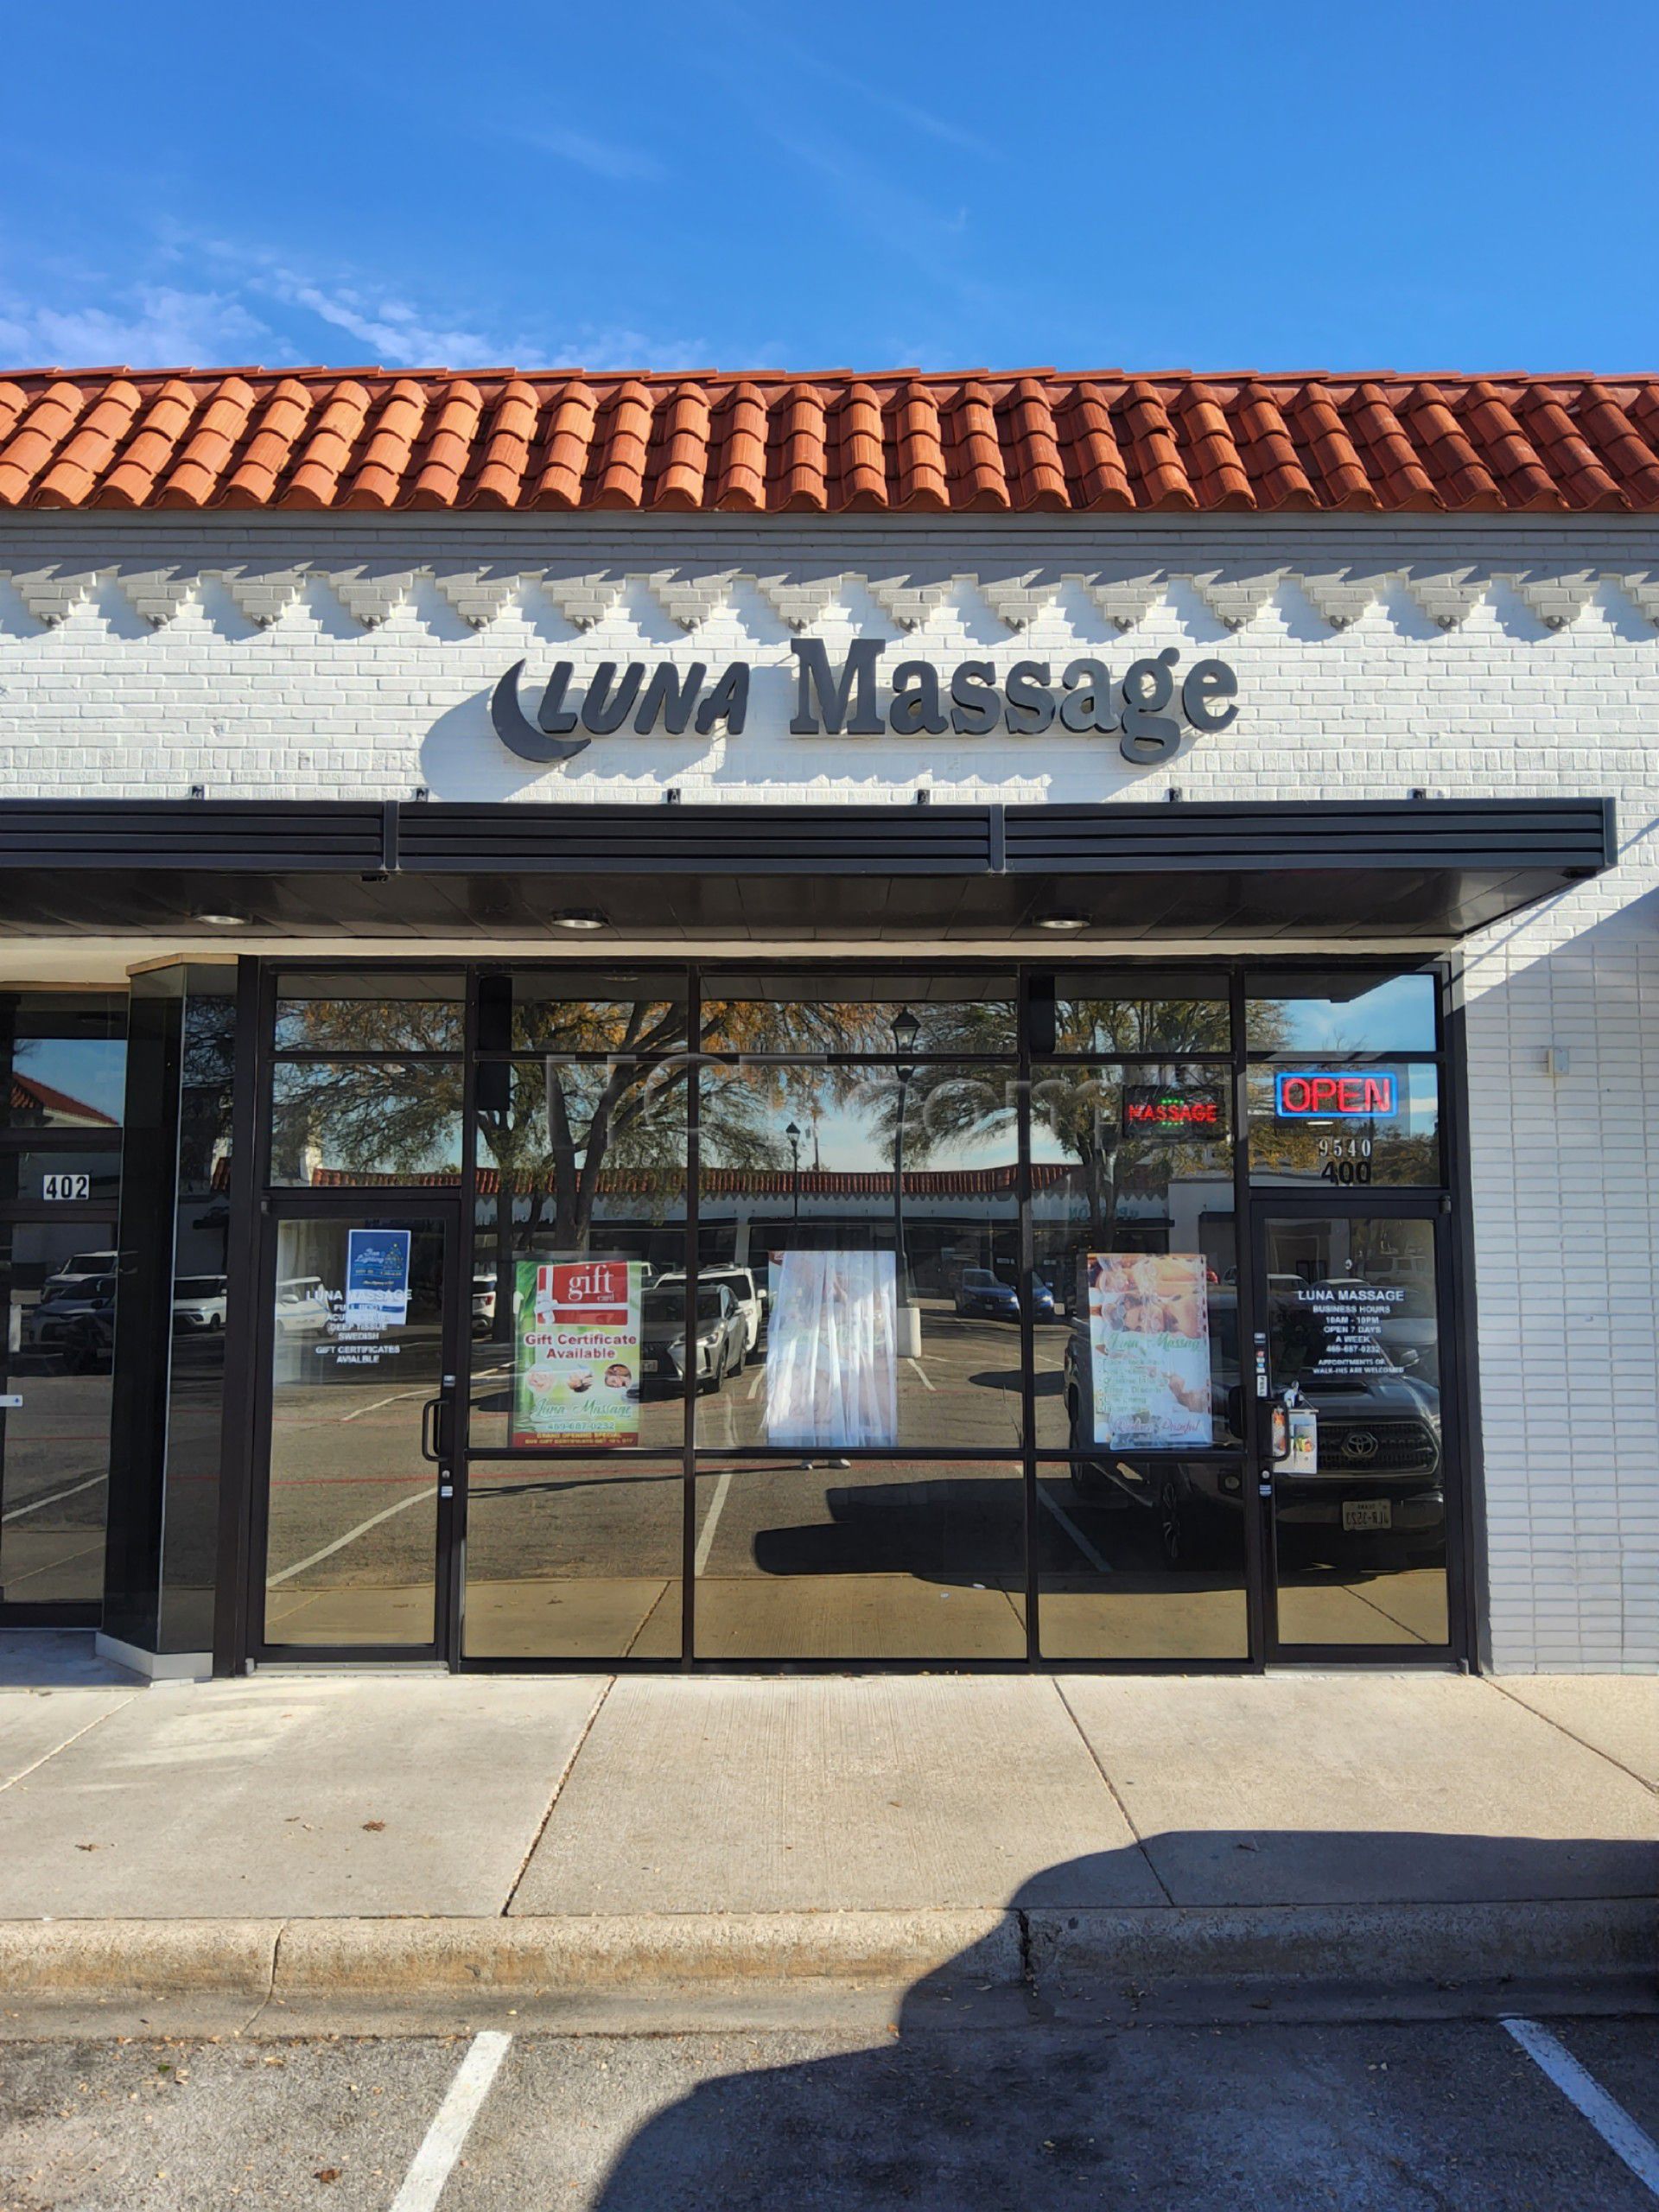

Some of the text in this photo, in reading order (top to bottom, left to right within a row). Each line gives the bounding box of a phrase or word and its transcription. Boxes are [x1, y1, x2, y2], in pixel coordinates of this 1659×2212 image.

[537, 638, 1240, 765] LUNA Massage
[1283, 1077, 1390, 1112] OPEN
[1128, 1104, 1217, 1122] MASSAGE
[1319, 1139, 1371, 1157] 9540
[1321, 1161, 1371, 1185] 400
[46, 1176, 87, 1198] 402
[568, 1264, 614, 1301] gift
[305, 1289, 413, 1300] LUNA MASSAGE
[1298, 1290, 1404, 1301] LUNA MASSAGE
[1313, 1305, 1390, 1313] BUSINESS HOURS
[525, 1334, 637, 1345] Gift Certificate
[337, 1345, 401, 1354] CERTIFICATES
[546, 1348, 616, 1359] Available
[534, 1398, 632, 1418] Luna Massage
